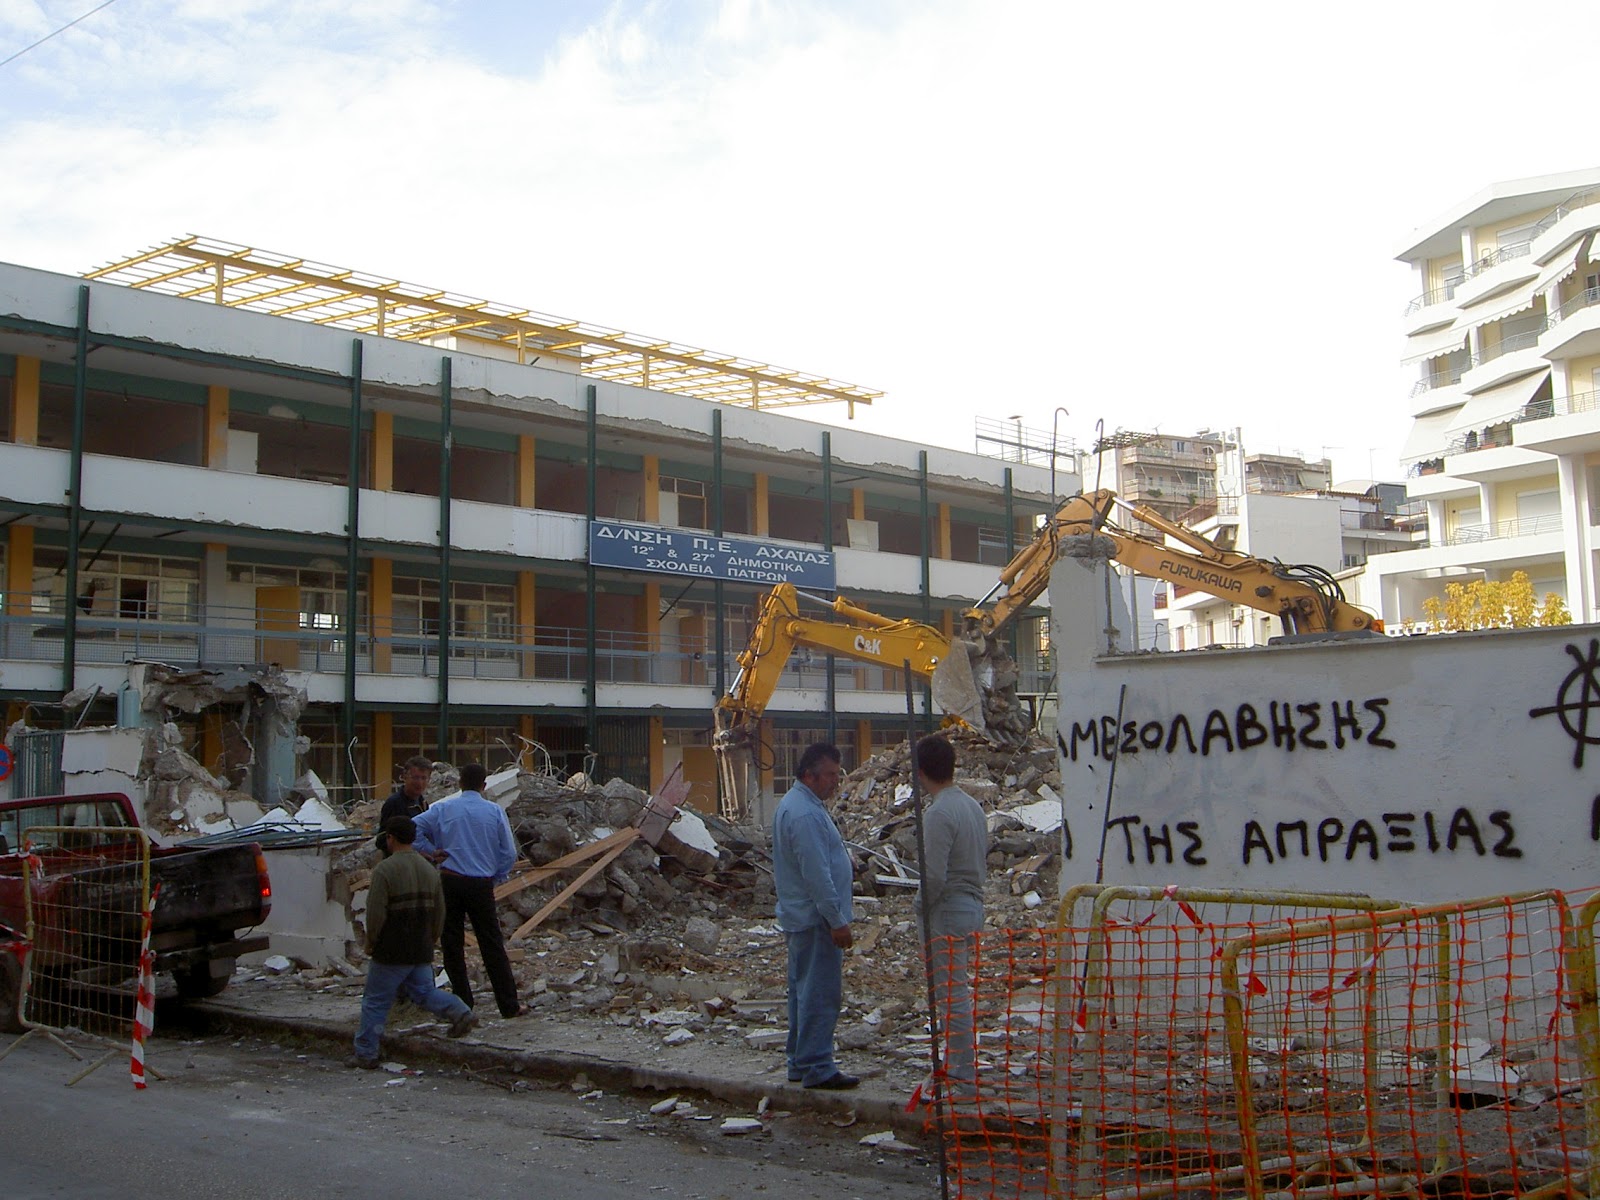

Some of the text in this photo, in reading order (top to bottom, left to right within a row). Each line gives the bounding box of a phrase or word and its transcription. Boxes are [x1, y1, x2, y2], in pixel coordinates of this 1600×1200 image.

[597, 526, 672, 545] Δ/ΝΣΗ
[693, 538, 738, 554] Π.Ε.
[646, 558, 787, 582] ΣΧΟΛΕΙΑ ΠΑΤΡΩΝ
[667, 549, 678, 559] &
[727, 556, 804, 573] ΔΗΜΟΤΙΚΑ
[1160, 560, 1242, 592] FURUKAWA
[1106, 815, 1208, 867] ΤΗΣ
[1242, 807, 1524, 866] ΑΠΡΑΞΙΑΣ
